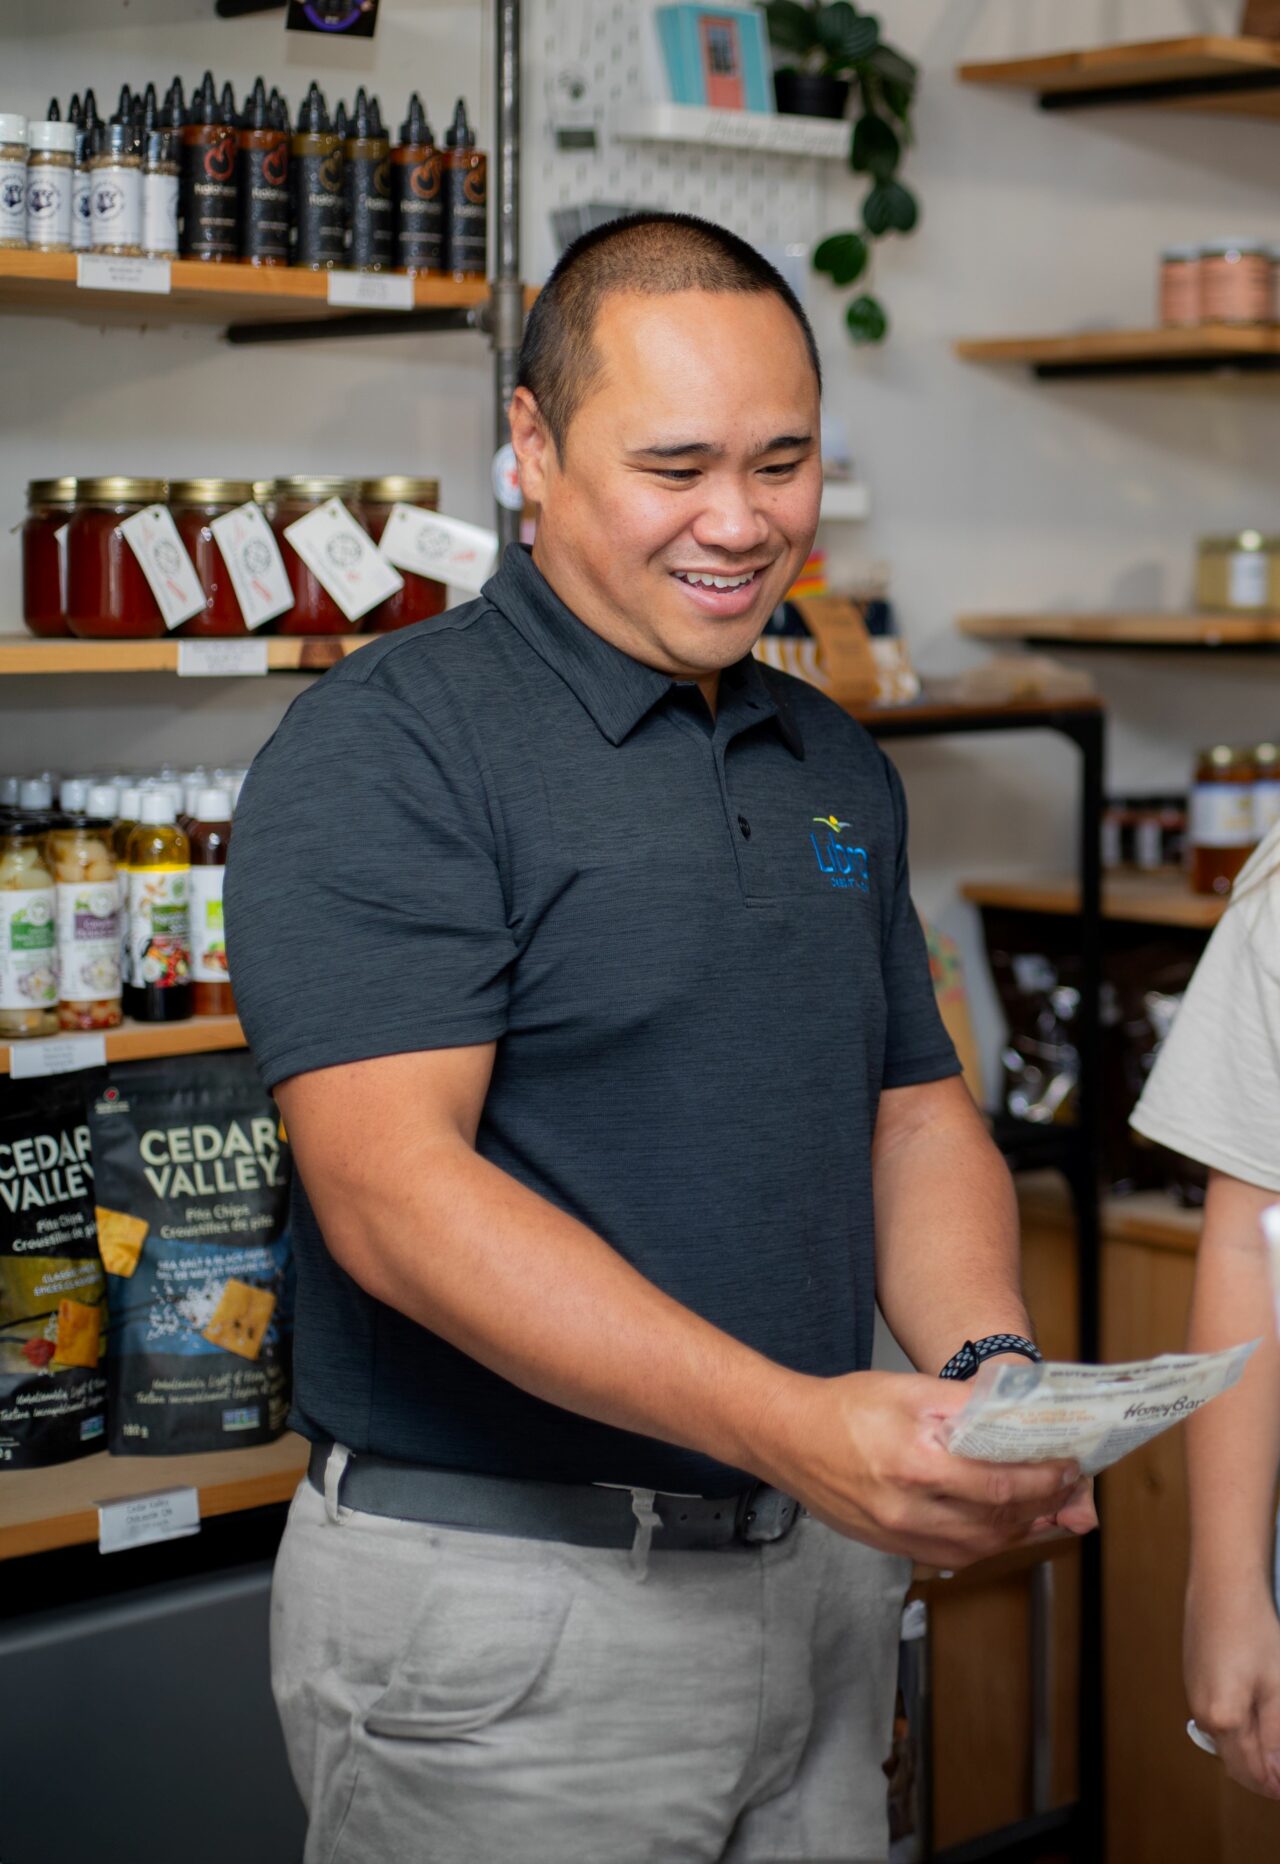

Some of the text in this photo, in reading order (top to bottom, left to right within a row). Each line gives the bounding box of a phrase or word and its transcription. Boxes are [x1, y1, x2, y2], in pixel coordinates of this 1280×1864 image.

[0, 1125, 92, 1180] CEDAR
[140, 1117, 280, 1166] CEDAR
[143, 1152, 280, 1199] VALLEY
[213, 1202, 251, 1220] Chips
